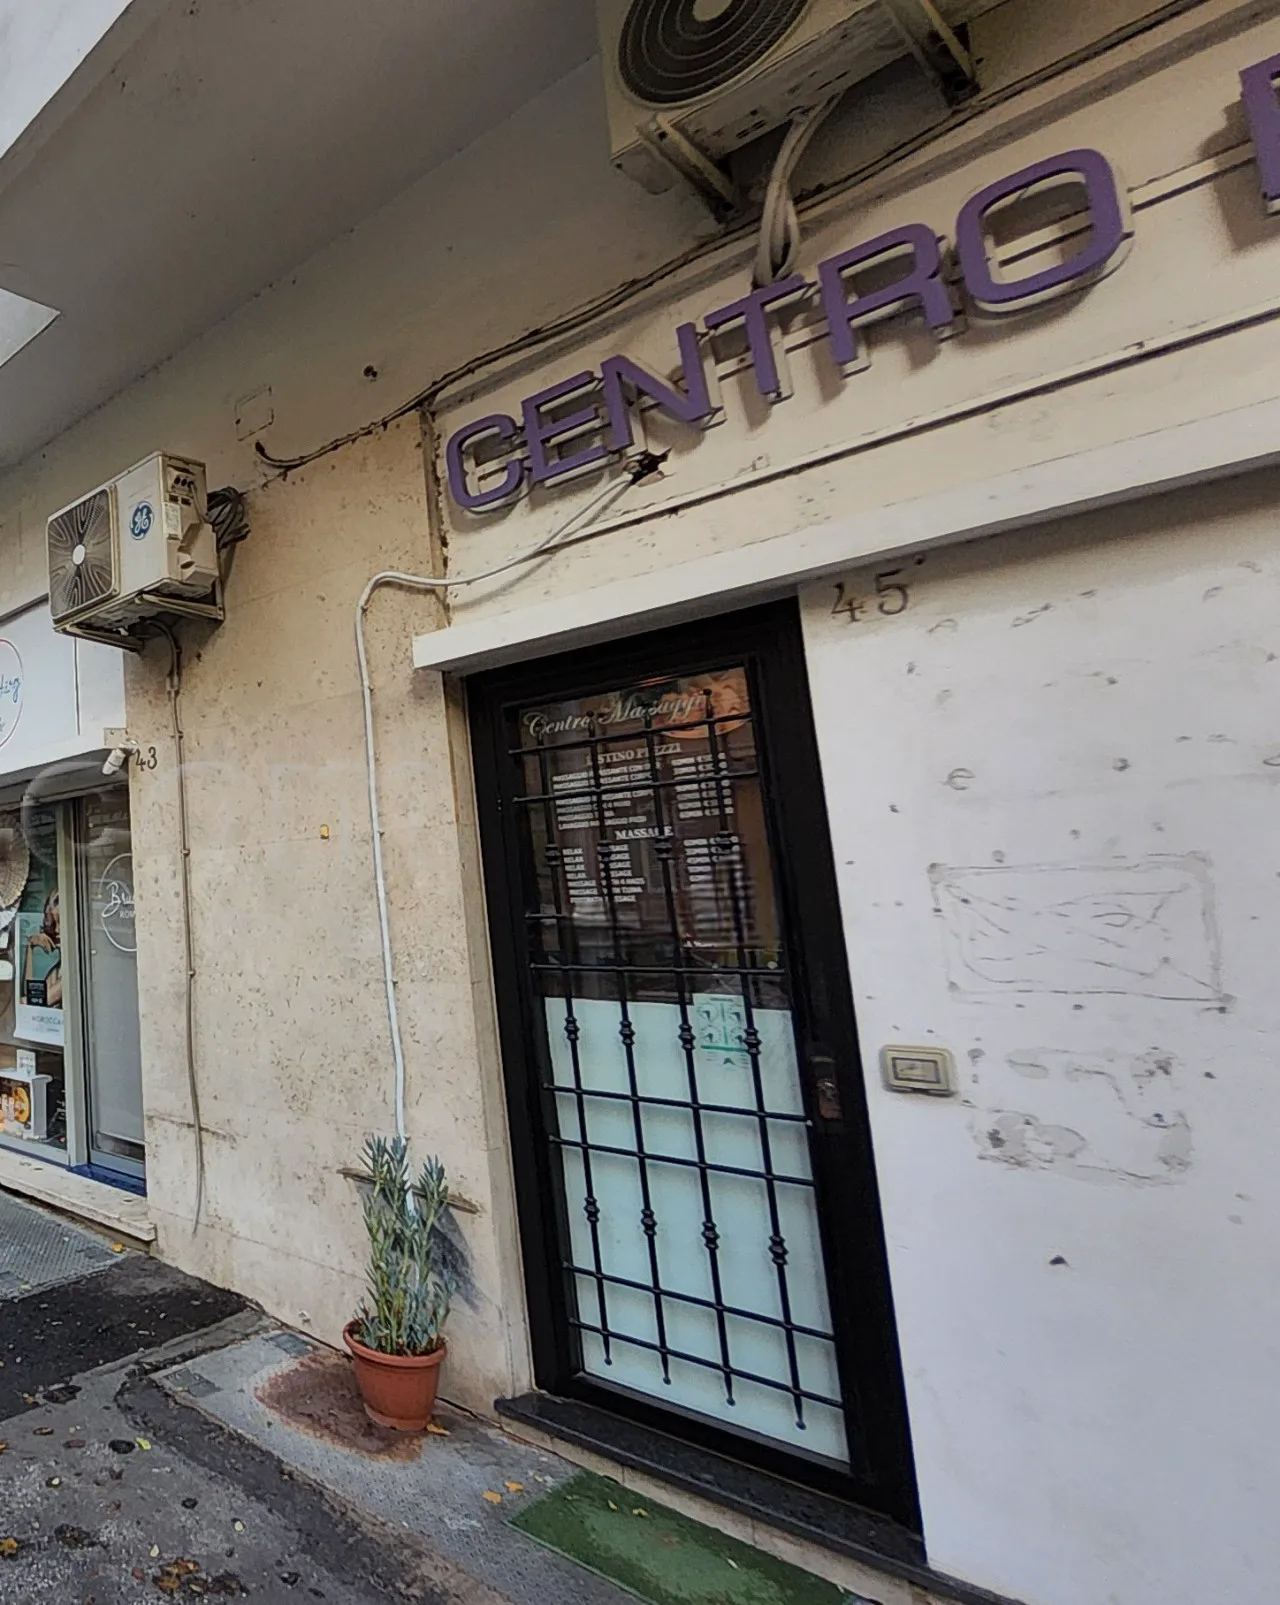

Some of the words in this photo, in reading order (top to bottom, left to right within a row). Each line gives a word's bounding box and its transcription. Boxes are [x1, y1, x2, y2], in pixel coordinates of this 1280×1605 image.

[445, 148, 1126, 512] CENTRO
[830, 570, 910, 622] 45
[523, 711, 591, 738] Centro
[134, 745, 158, 772] 43
[586, 749, 635, 766] LSTINO
